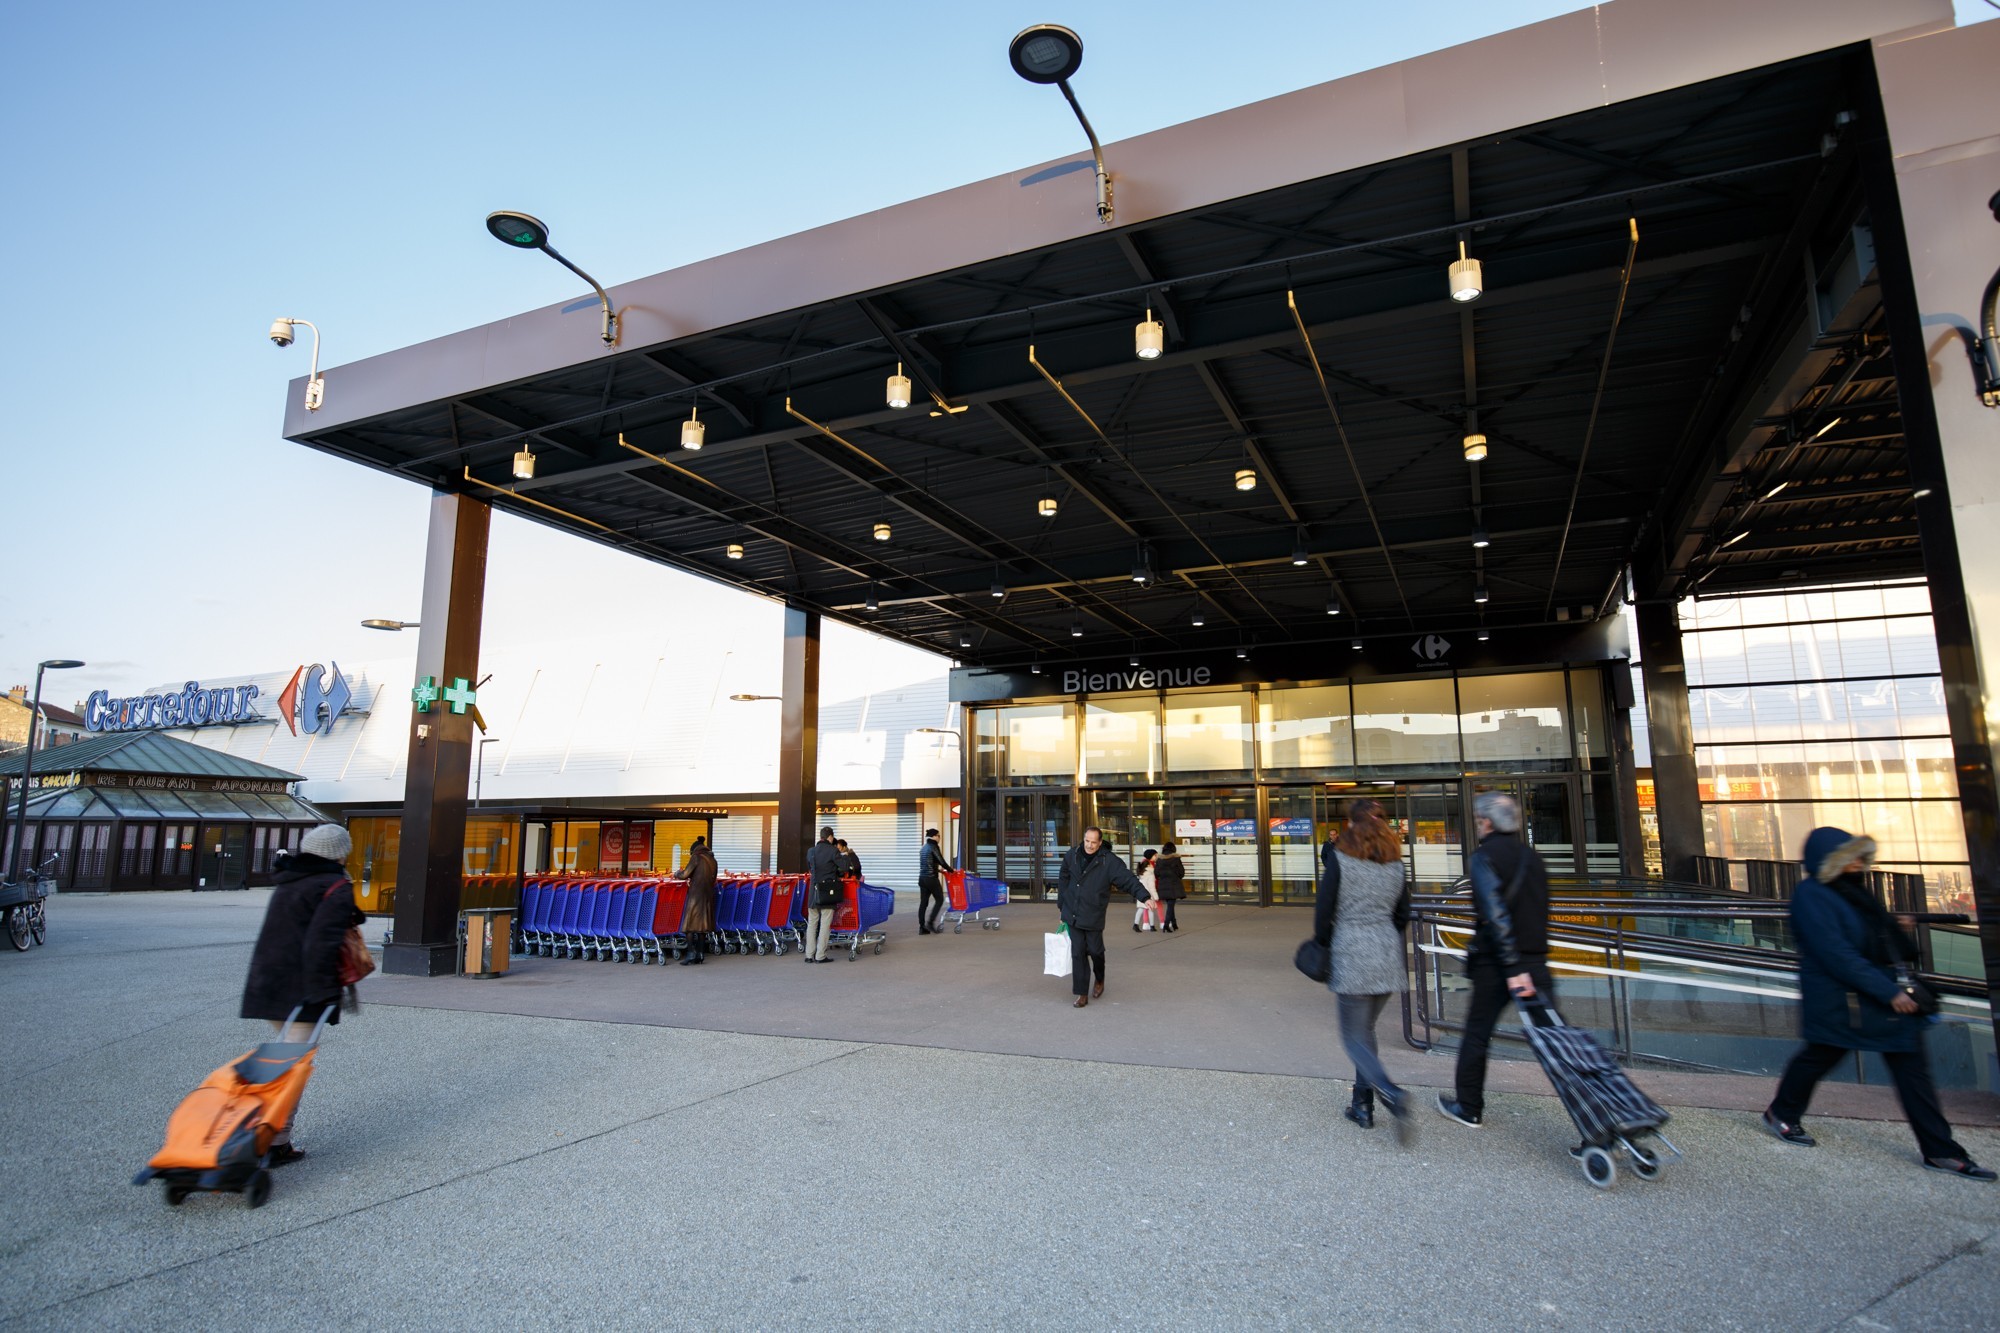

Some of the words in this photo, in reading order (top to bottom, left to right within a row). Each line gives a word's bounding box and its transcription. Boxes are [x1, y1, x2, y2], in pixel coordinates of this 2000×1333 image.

[1063, 666, 1211, 693] Bienvenue
[85, 681, 259, 732] Carrefour
[212, 780, 283, 792] JAPONAIS
